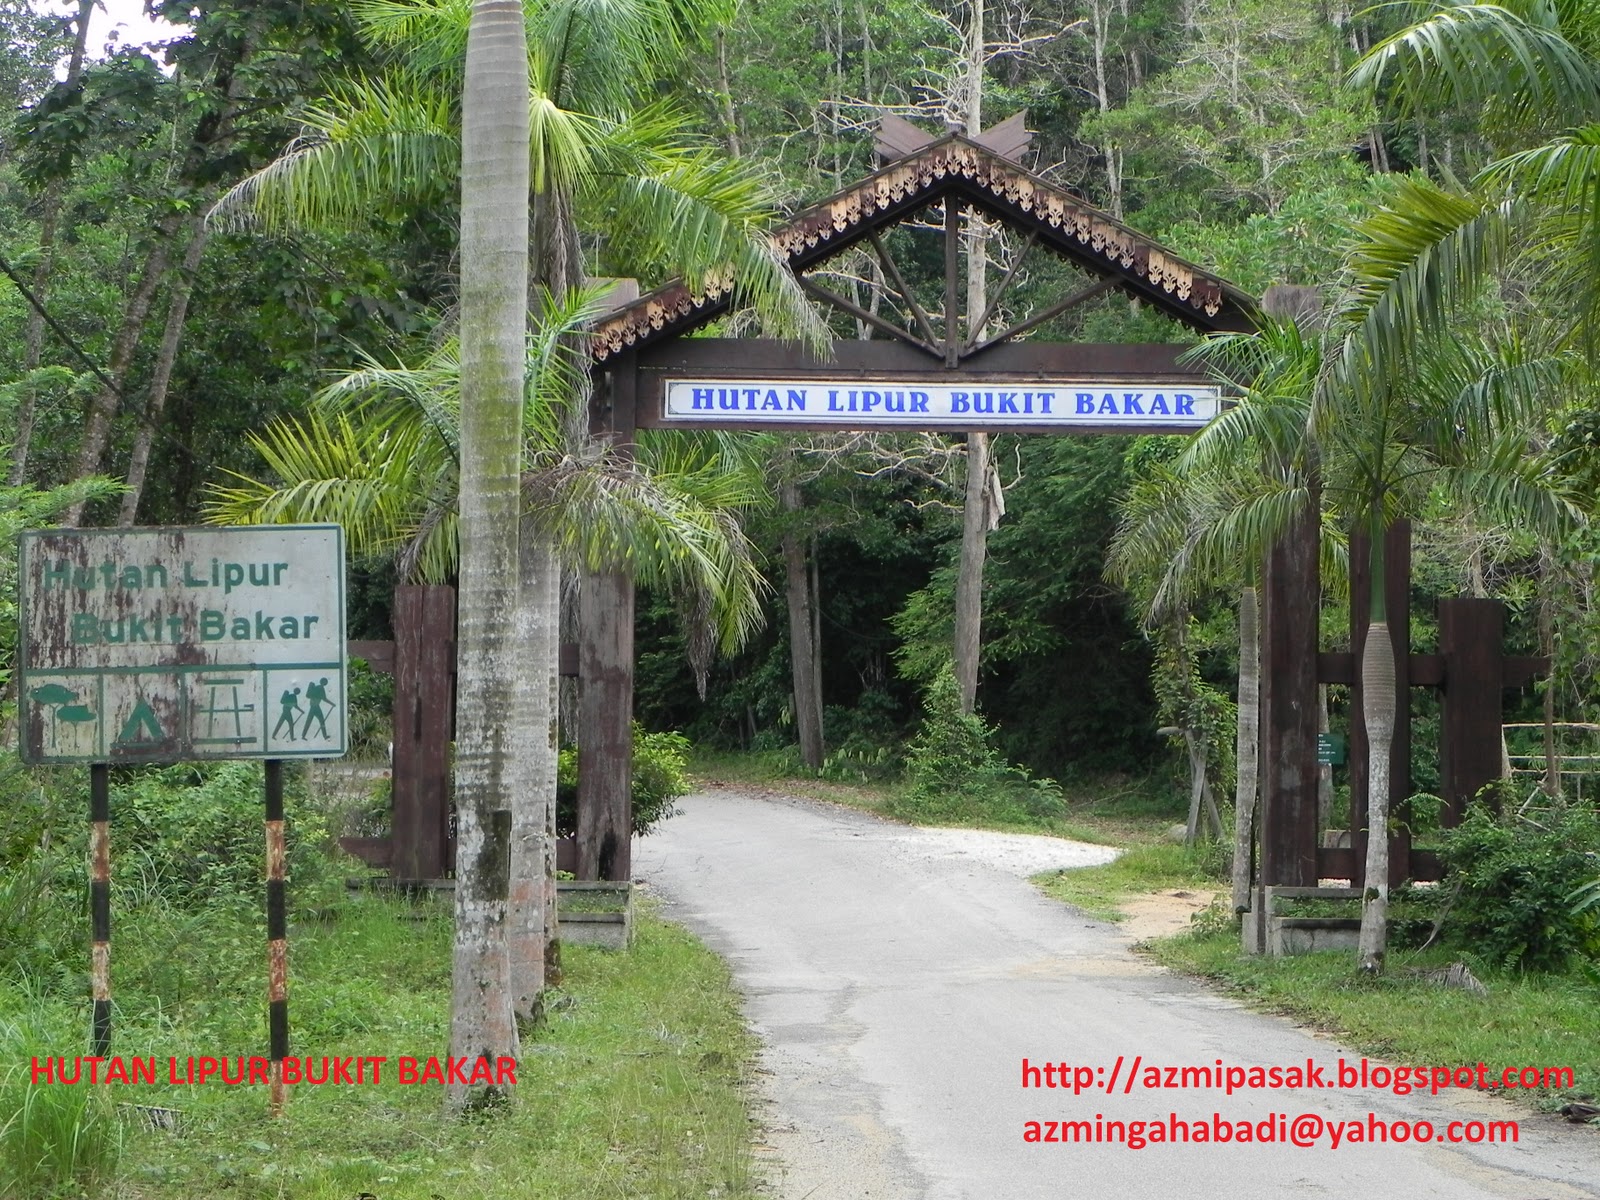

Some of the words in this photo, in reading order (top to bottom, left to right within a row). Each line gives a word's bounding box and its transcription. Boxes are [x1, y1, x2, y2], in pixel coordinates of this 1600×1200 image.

[691, 388, 807, 411] HUTAN
[827, 390, 930, 413] LIPUR
[950, 391, 1056, 414] BUKIT
[1075, 392, 1195, 416] BAKAR
[43, 559, 168, 591] Hutan
[184, 558, 289, 594] Lipur
[72, 612, 185, 644] Bukit
[200, 610, 319, 641] Bakar
